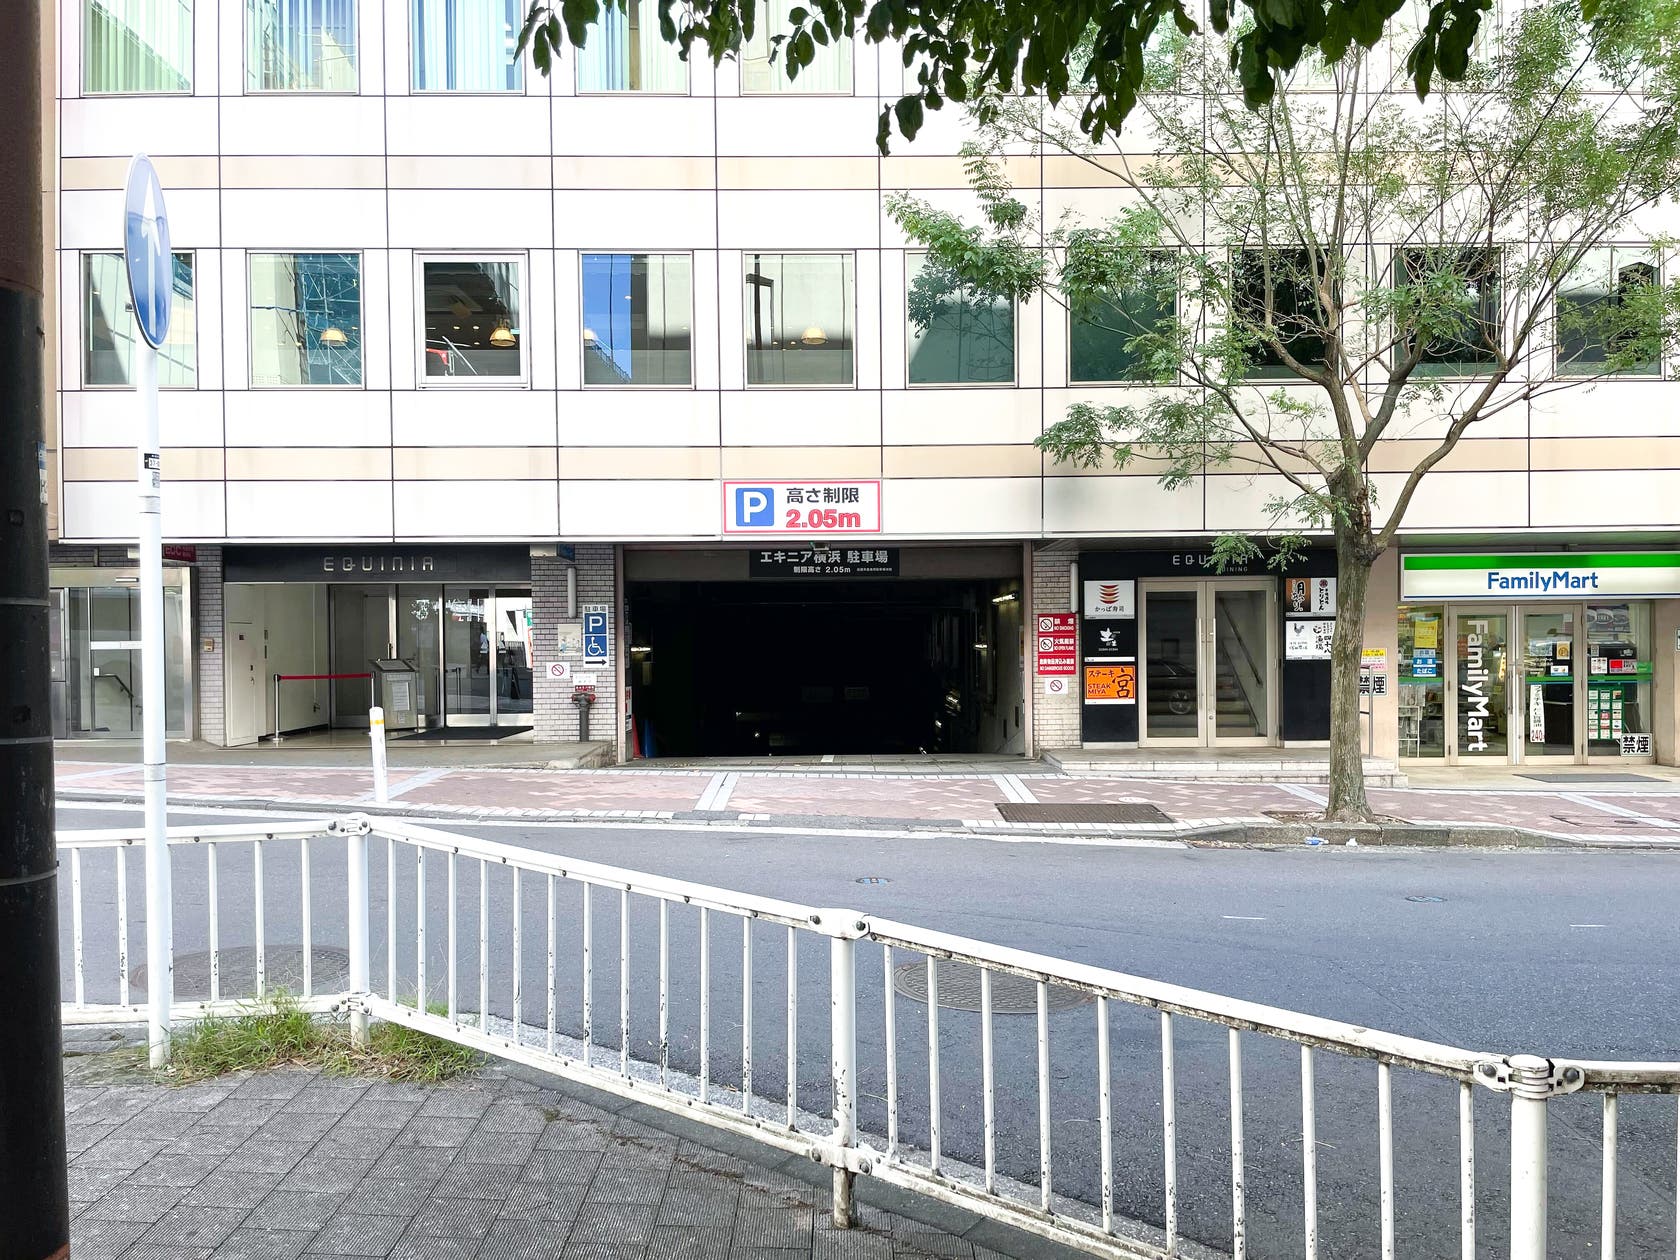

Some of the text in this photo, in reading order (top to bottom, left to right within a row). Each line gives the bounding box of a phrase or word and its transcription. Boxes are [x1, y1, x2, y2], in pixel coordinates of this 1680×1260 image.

[786, 487, 860, 504] 高さ制限
[743, 491, 768, 523] P
[785, 508, 861, 528] 2.05m
[323, 556, 433, 571] EQUINIA
[760, 550, 888, 564] エキニア横浜 駐車場
[1172, 554, 1248, 566] EQUIA
[825, 566, 851, 574] 2.05m
[1487, 571, 1599, 592] FamilyMart
[589, 616, 603, 632] P
[1088, 669, 1115, 678] ステーキ
[1111, 667, 1135, 699] 宮
[1358, 675, 1385, 695] 禁煙
[1462, 620, 1489, 752] FamilyMart
[1622, 735, 1649, 754] 禁煙
